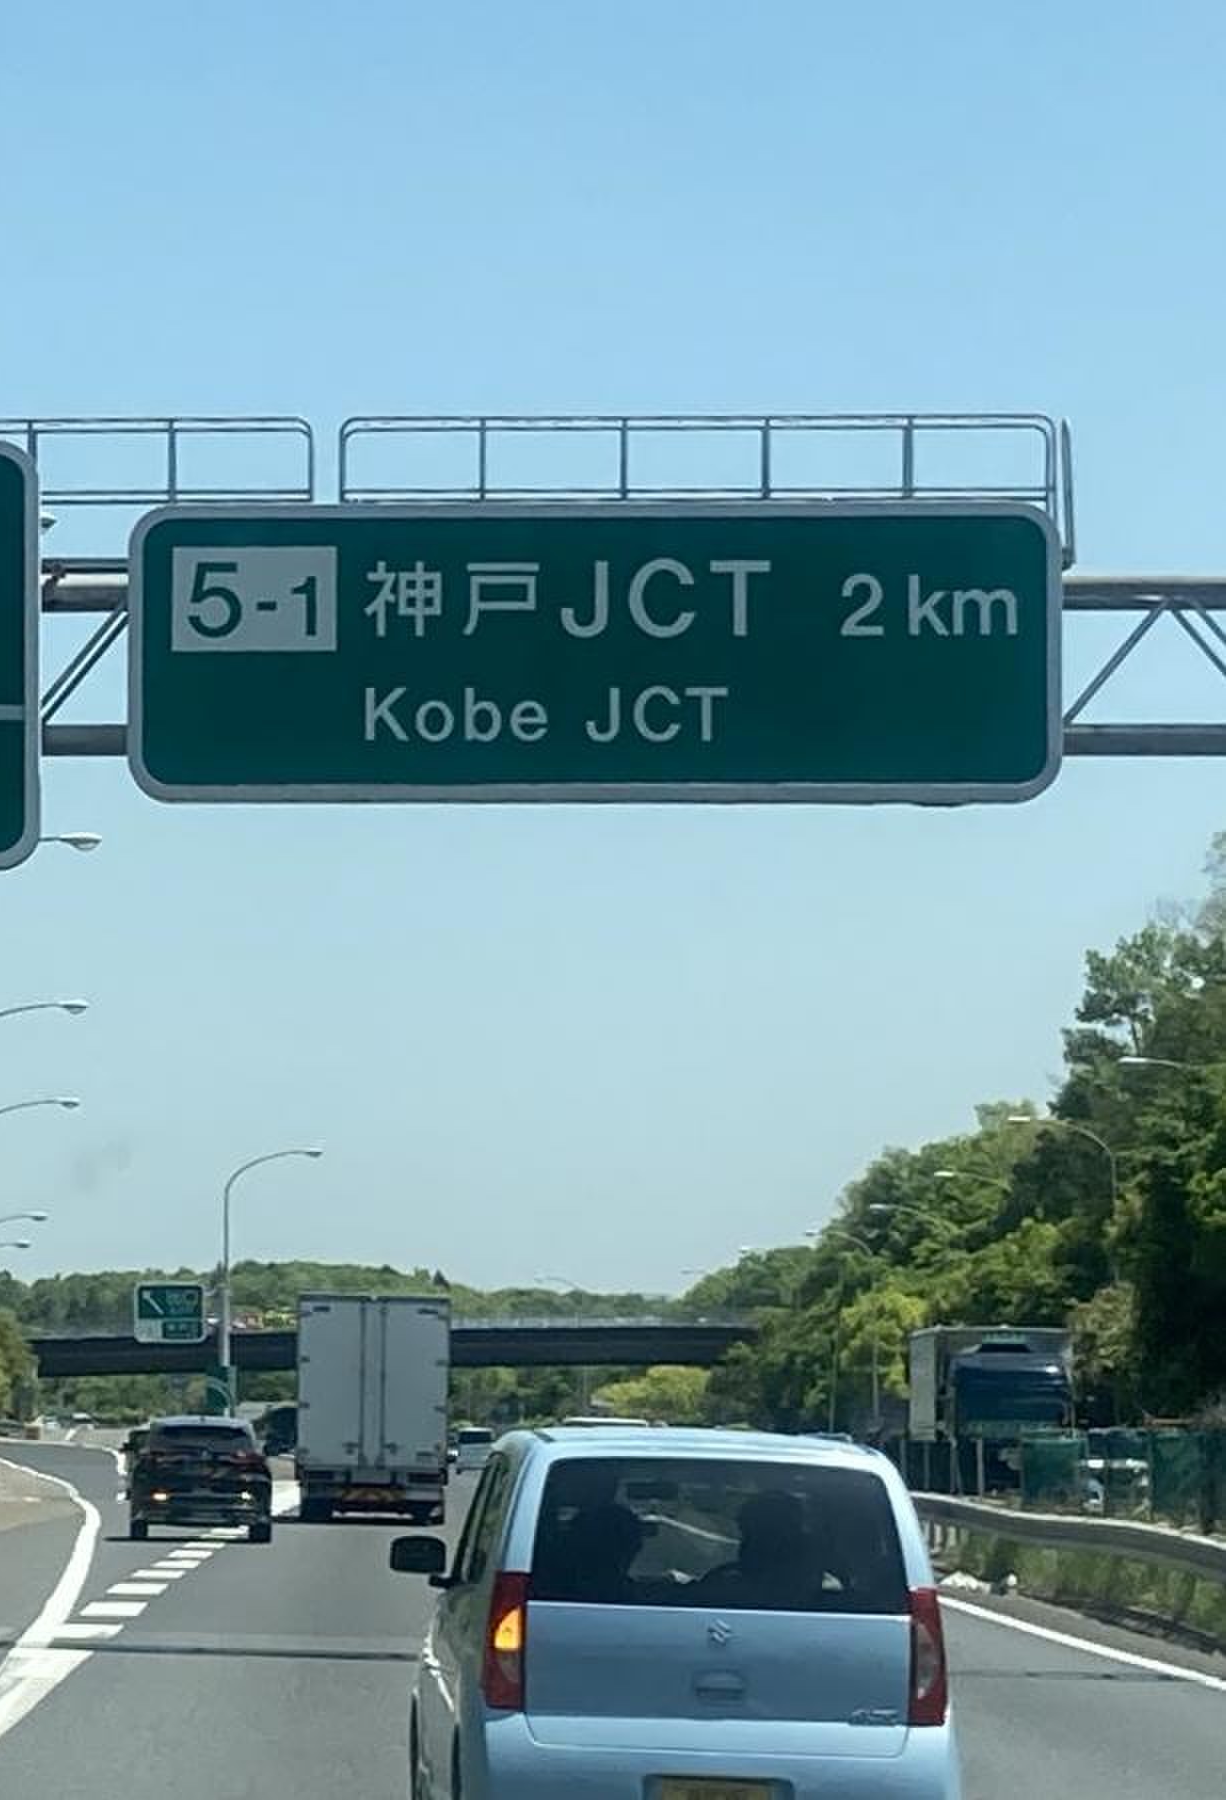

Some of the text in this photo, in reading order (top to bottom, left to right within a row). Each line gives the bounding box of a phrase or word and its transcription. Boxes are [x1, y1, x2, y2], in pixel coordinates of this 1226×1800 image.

[186, 562, 317, 638] 5-1
[364, 686, 729, 742] Kobe JCT
